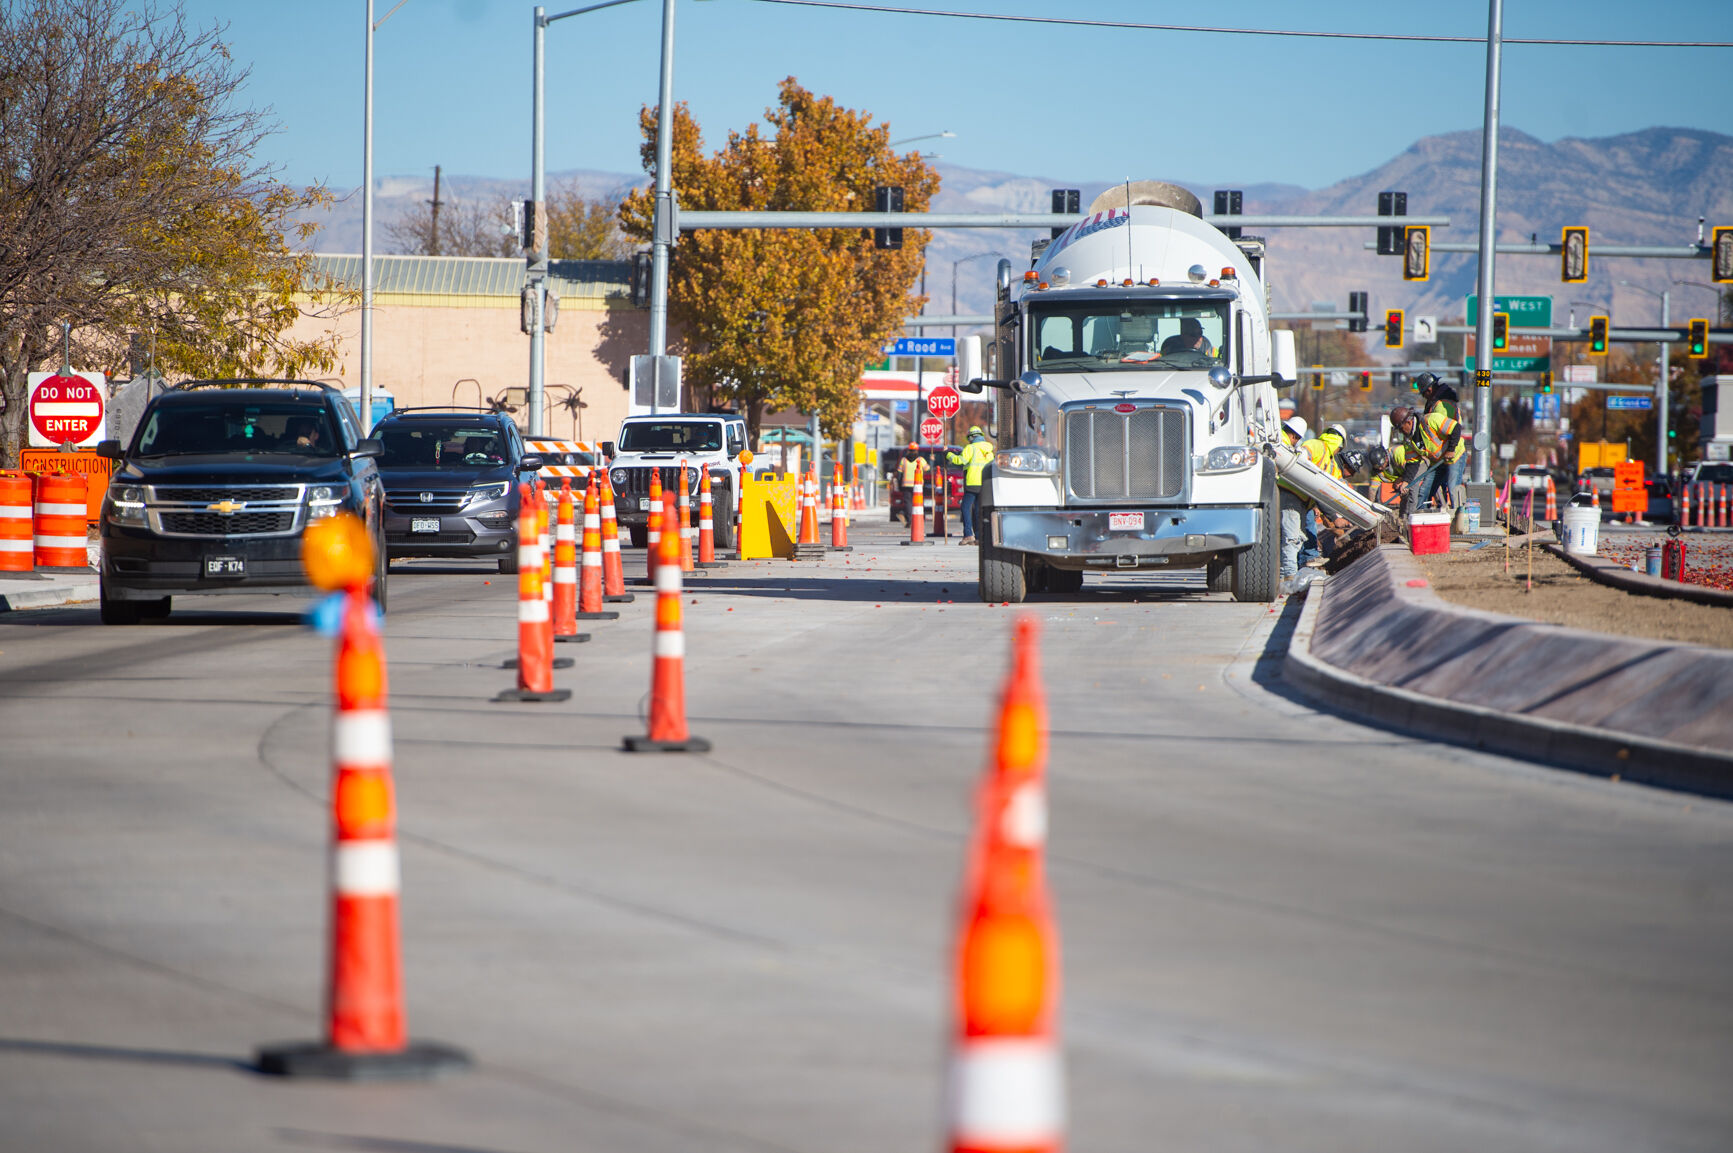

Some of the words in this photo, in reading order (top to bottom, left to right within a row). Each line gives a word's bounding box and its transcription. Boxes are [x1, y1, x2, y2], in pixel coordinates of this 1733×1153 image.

[907, 340, 937, 353] Rood
[40, 386, 59, 399] DO
[66, 386, 93, 399] NOT
[930, 395, 958, 409] STOP
[46, 419, 88, 432] ENTER
[921, 424, 942, 434] STOP
[25, 458, 107, 474] CONSTRUCTION
